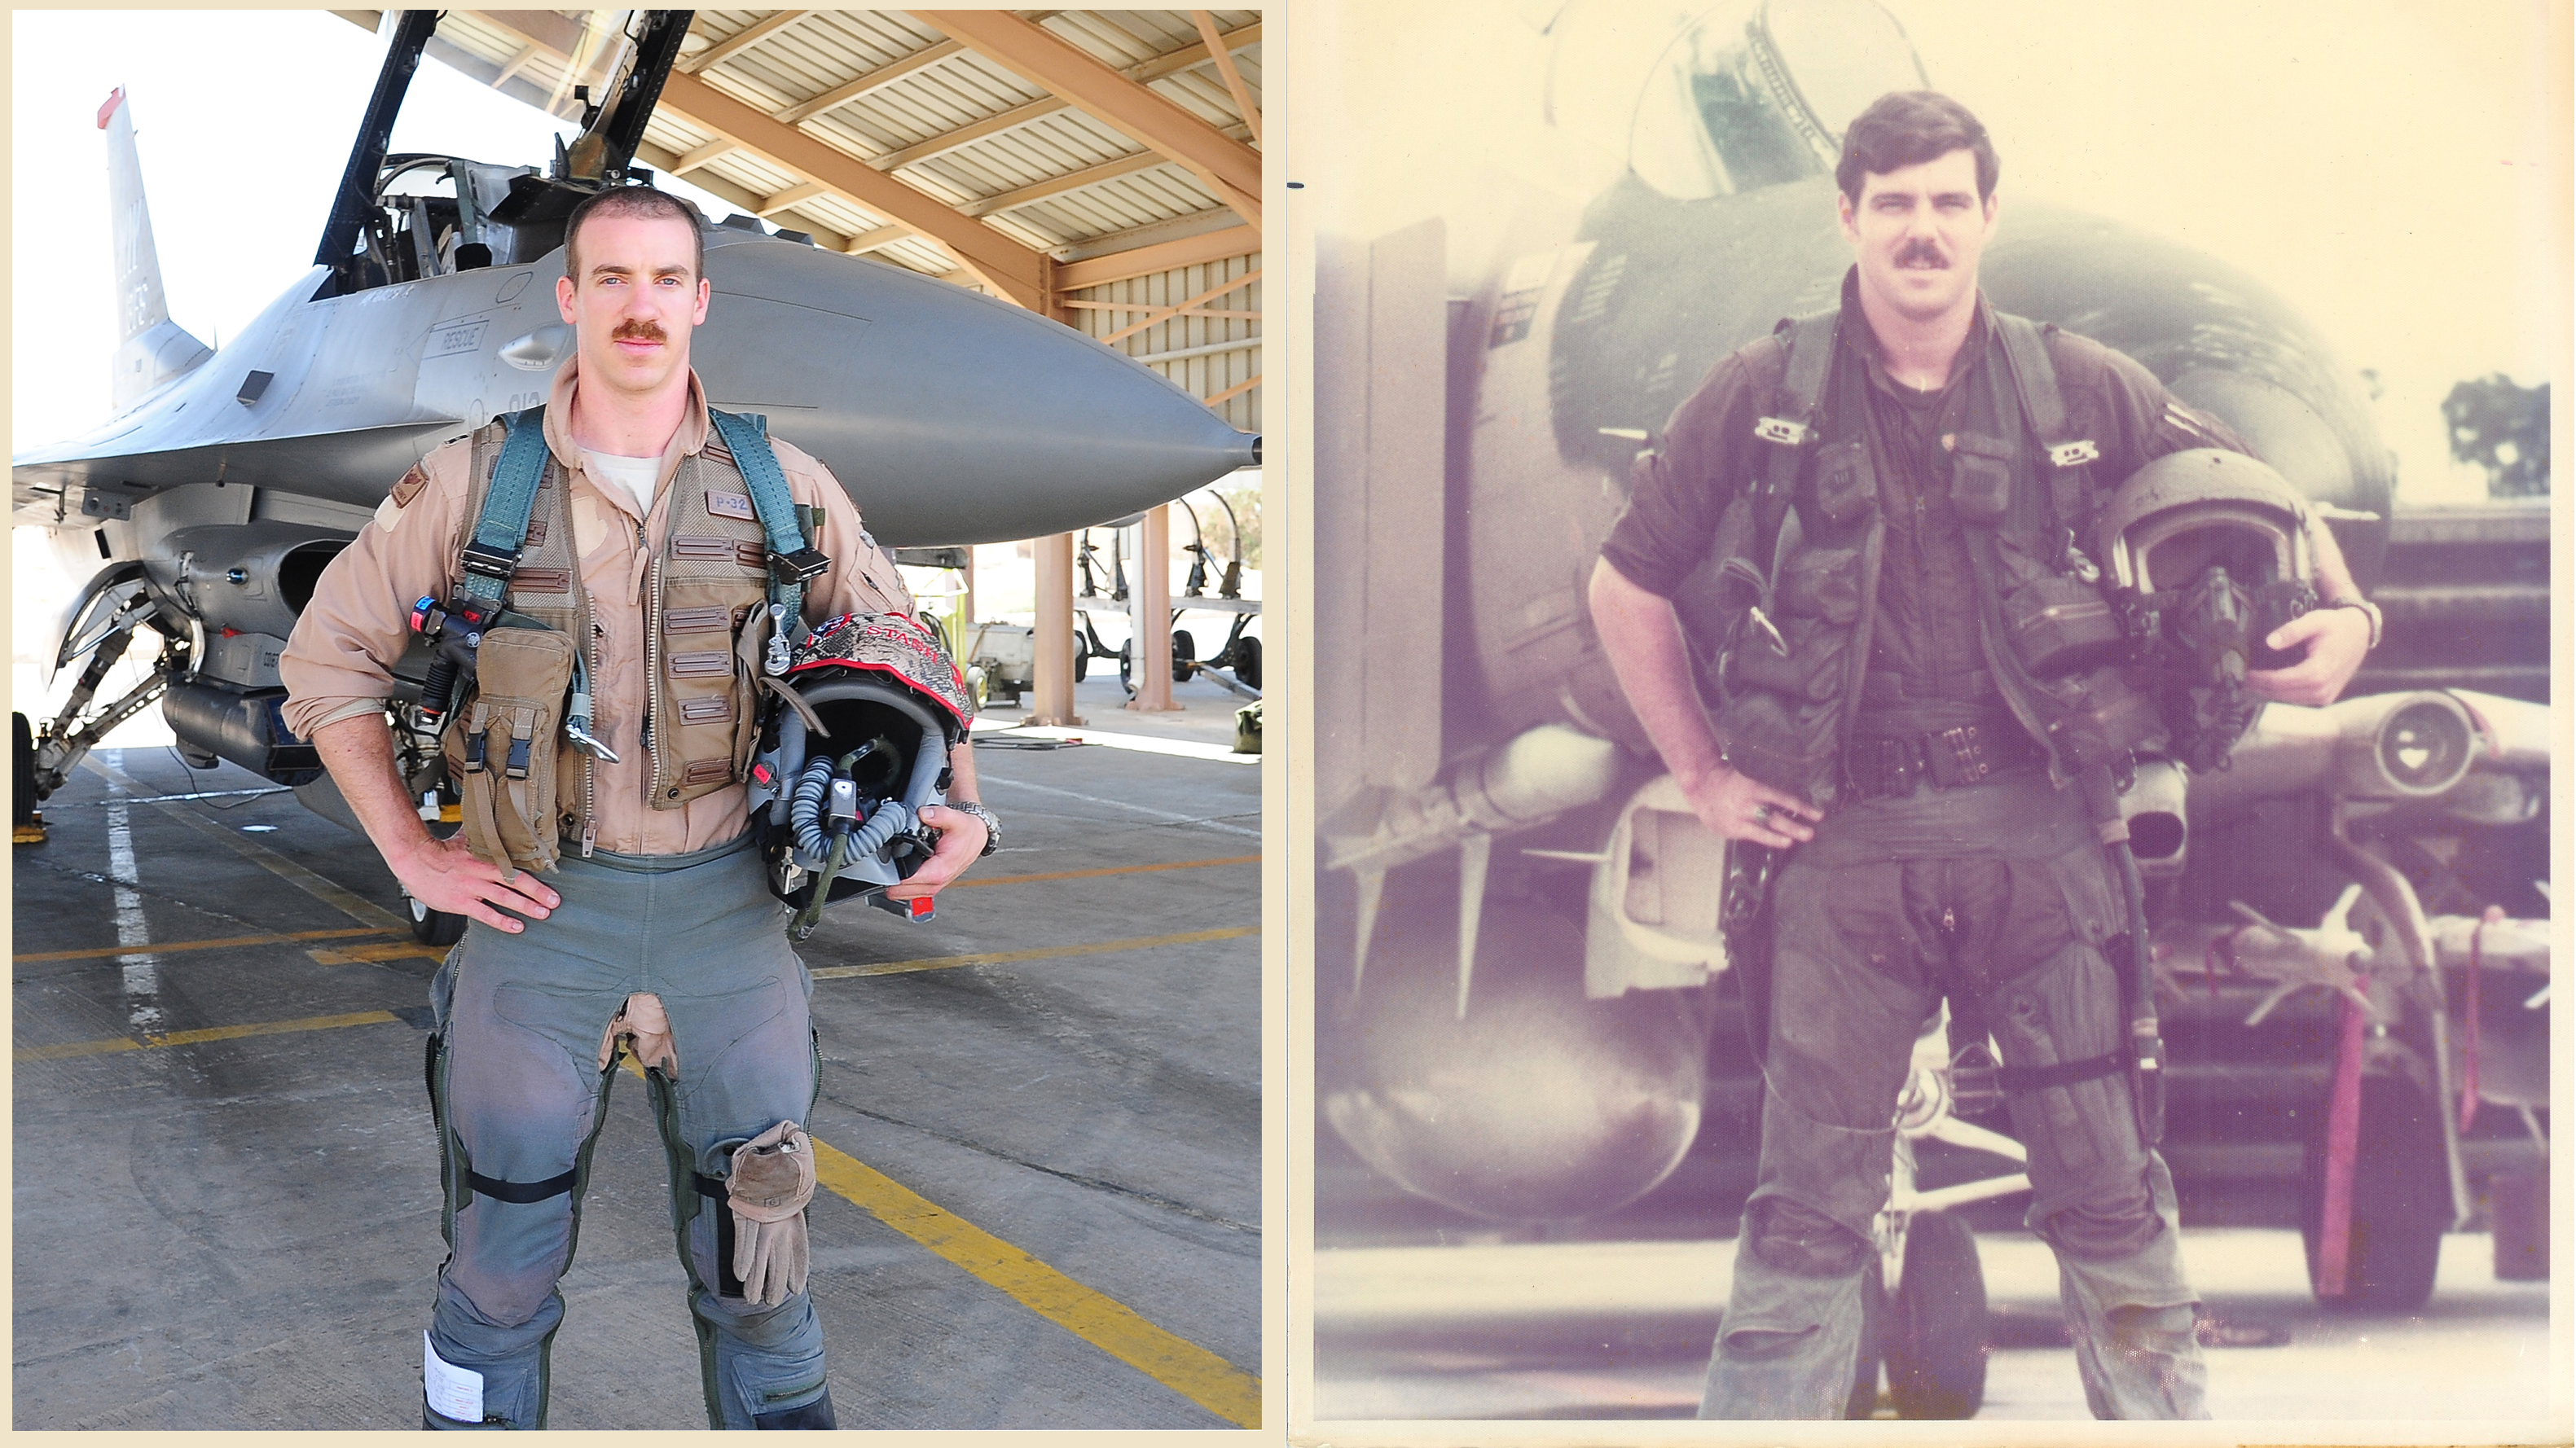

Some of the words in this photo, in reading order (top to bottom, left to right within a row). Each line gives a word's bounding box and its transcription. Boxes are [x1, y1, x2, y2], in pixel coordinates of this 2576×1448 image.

[441, 327, 479, 350] RESCUE
[716, 496, 749, 511] P-32
[867, 625, 939, 665] STASH
